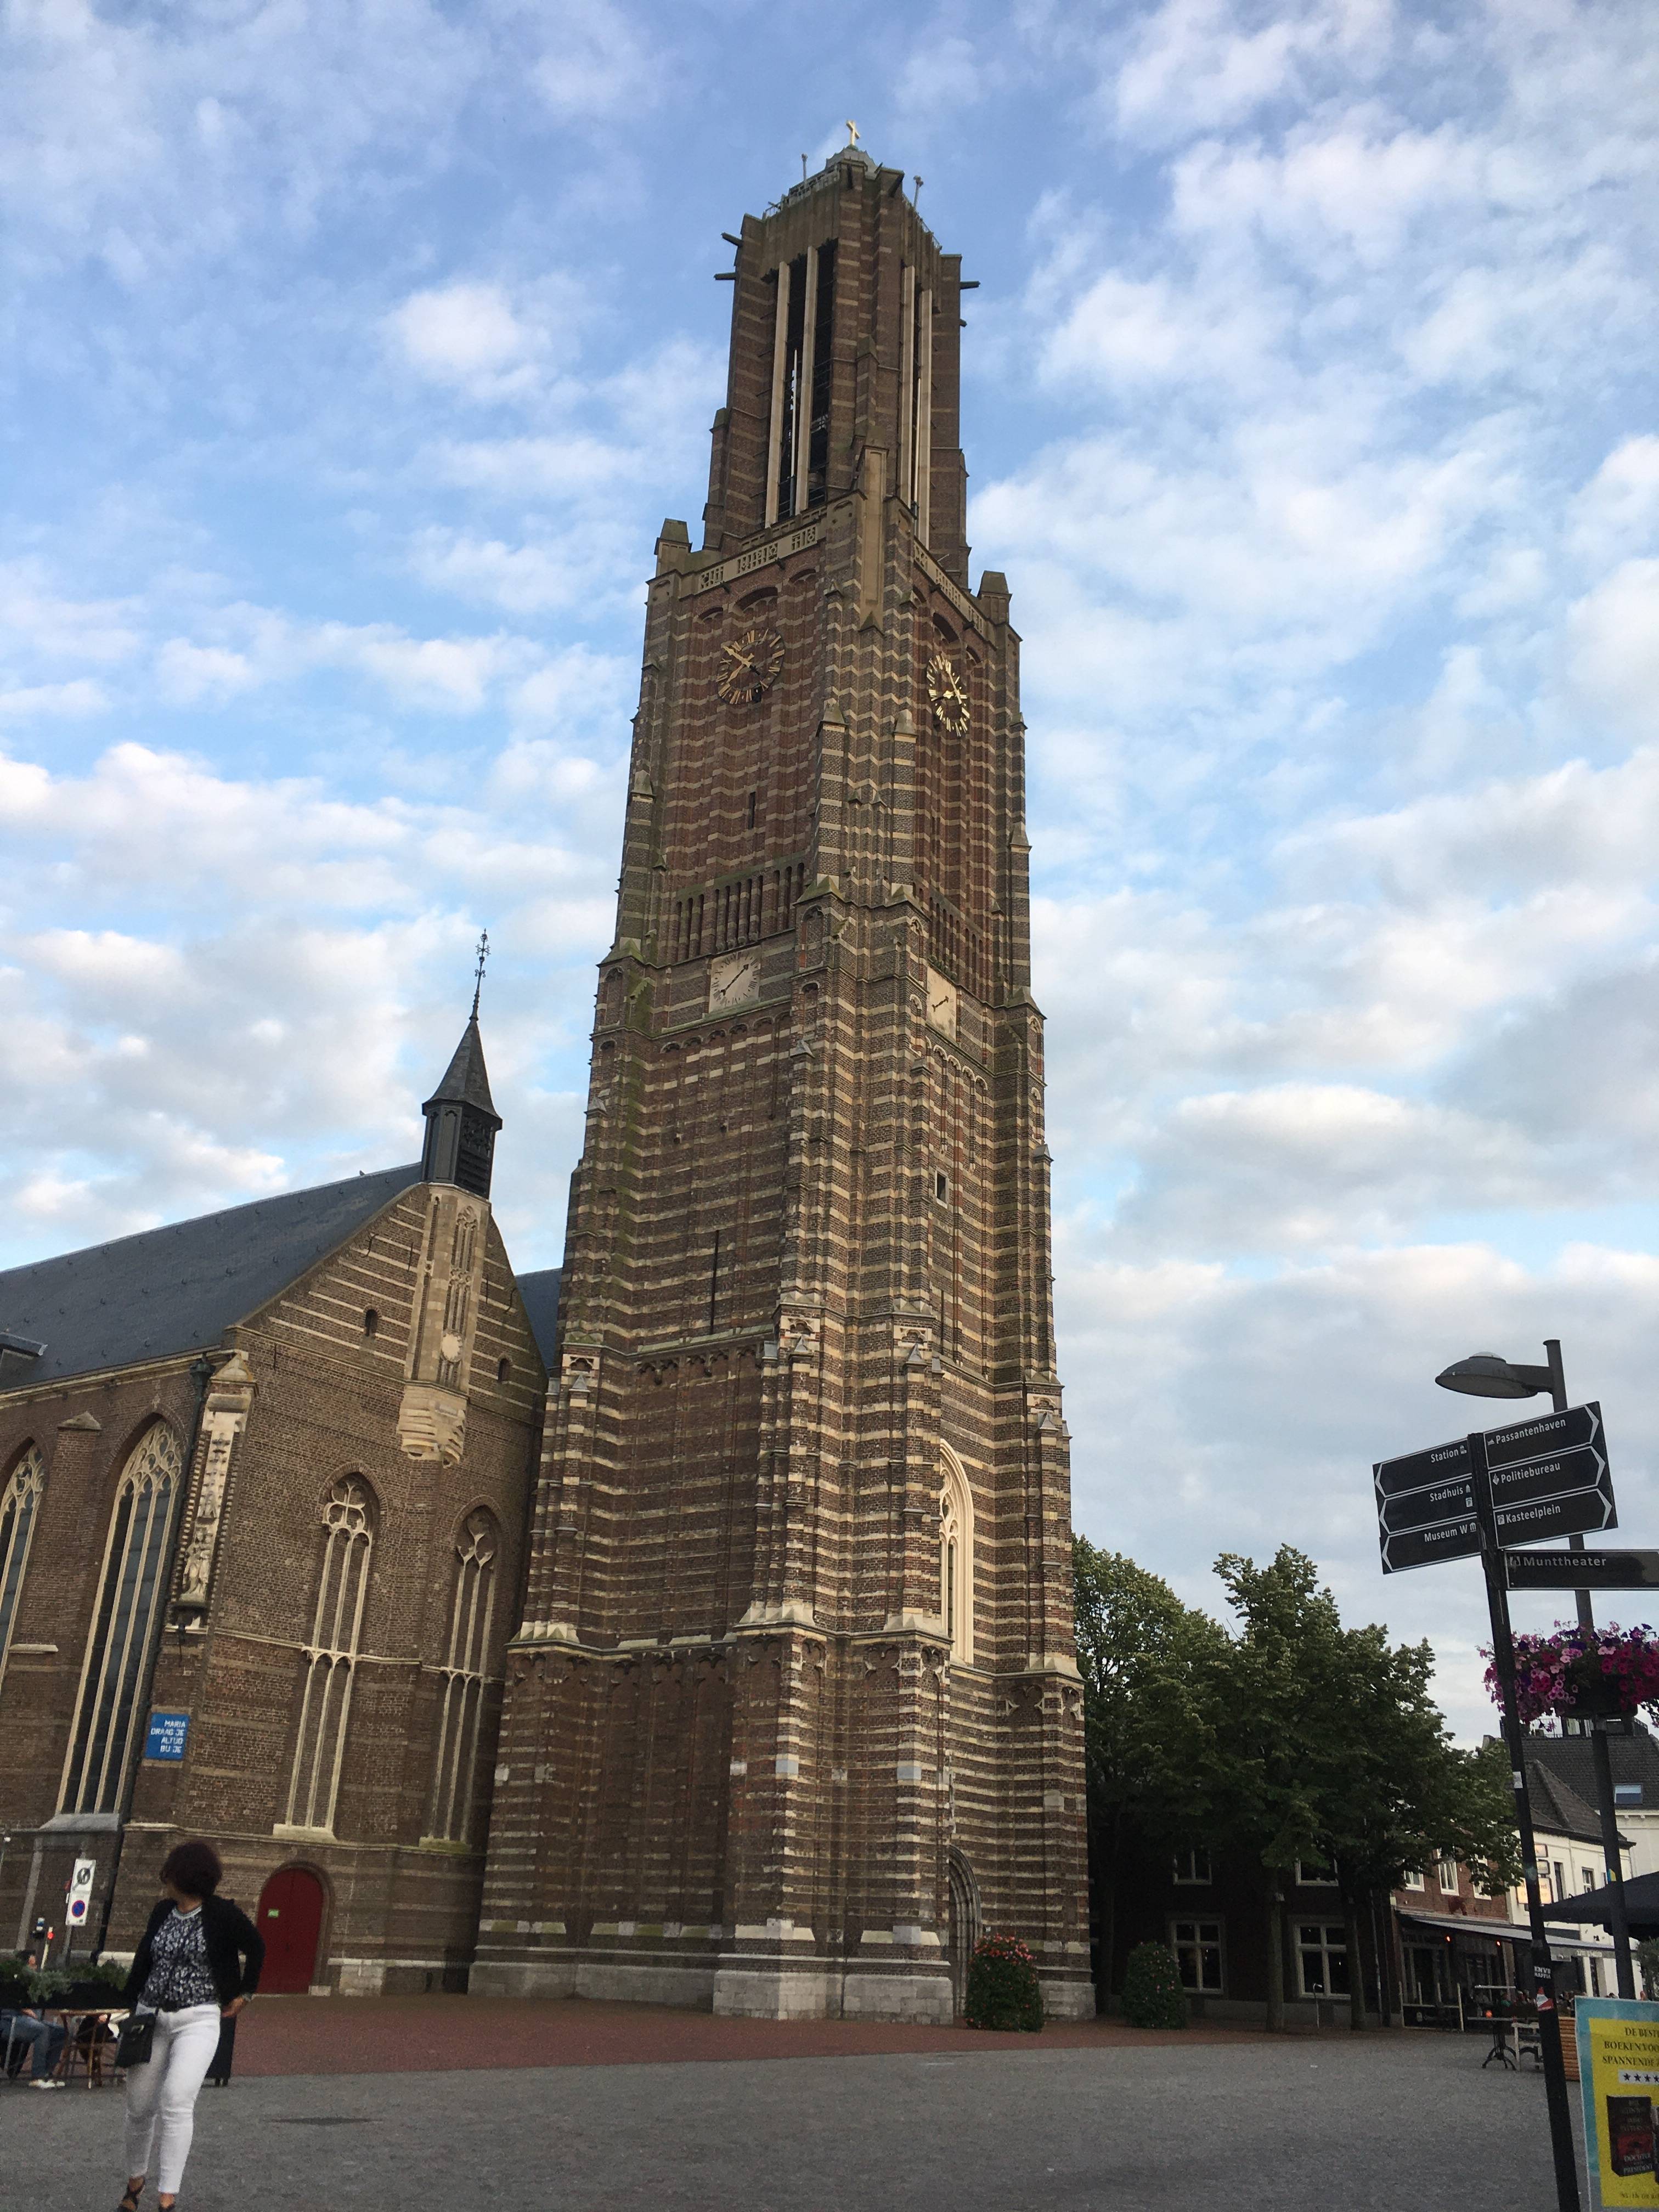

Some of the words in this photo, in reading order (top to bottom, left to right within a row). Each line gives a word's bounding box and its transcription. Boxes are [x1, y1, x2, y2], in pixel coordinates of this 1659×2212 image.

[1496, 1418, 1566, 1444] Passantenhaven
[1431, 1447, 1459, 1463] Station
[1501, 1462, 1561, 1483] Politiebureau
[1430, 1486, 1464, 1502] Stadhuis
[1506, 1504, 1561, 1524] Kasteelplein
[1425, 1528, 1458, 1542] Museum
[1459, 1524, 1468, 1534] W
[1523, 1556, 1607, 1566] Munttheater
[164, 1719, 185, 1728] MARIA
[1625, 2027, 1637, 2036] DE
